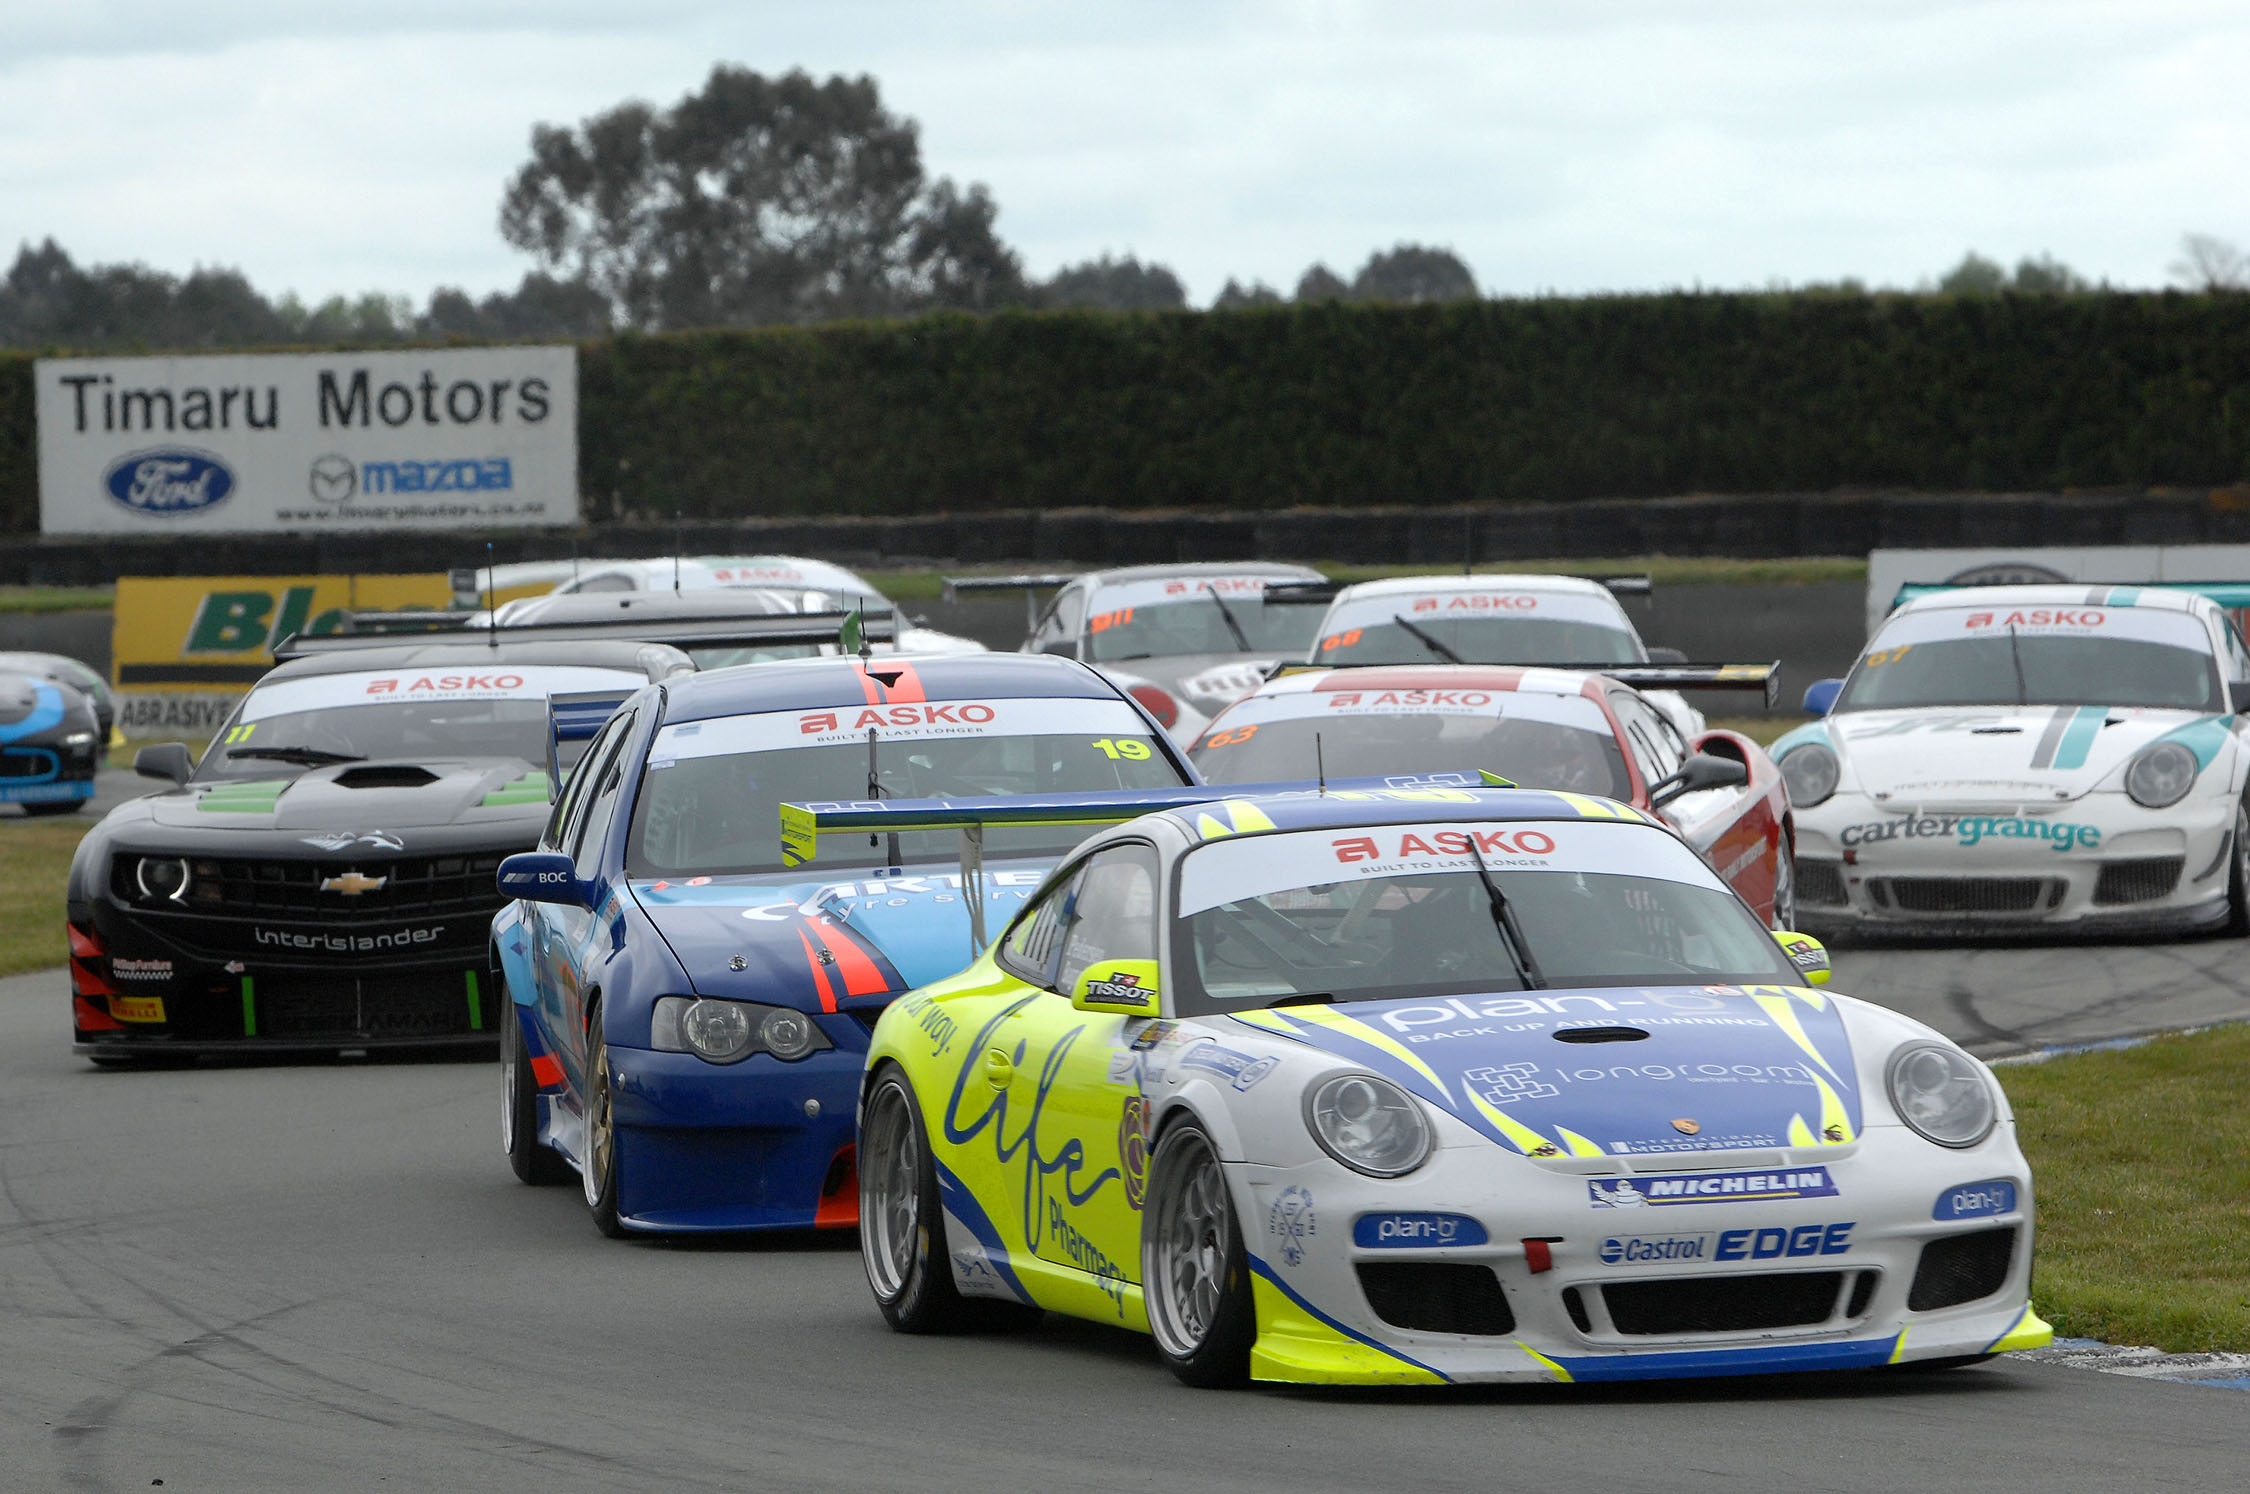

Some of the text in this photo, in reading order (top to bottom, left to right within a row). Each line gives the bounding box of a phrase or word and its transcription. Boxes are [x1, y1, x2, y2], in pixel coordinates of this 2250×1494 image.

[59, 368, 550, 433] Timaru Motors
[127, 459, 218, 506] Ford
[1448, 596, 1537, 610] ASKO
[1090, 608, 1133, 634] 911
[2004, 610, 2105, 626] ASKO
[408, 675, 524, 691] ASKO
[1373, 692, 1492, 707] ASKO
[855, 704, 996, 728] ASKO
[817, 733, 858, 743] BUILT
[886, 729, 919, 738] LAST
[926, 727, 984, 735] LONGER
[1208, 725, 1259, 748] 63
[1092, 738, 1152, 760] 19
[1400, 830, 1556, 857] ASKO
[1840, 813, 2102, 852] cartergrange
[539, 872, 567, 883] BOC
[1360, 858, 1550, 875] BUILT TO LAST LONGER
[255, 926, 445, 951] interislander
[1087, 981, 1156, 1000] TISSOT
[1381, 989, 1730, 1032] plan-b
[920, 1005, 958, 1058] way.
[1408, 1016, 1770, 1043] BACK UP AND RUNNING
[1556, 1063, 1811, 1084] longroom
[944, 993, 1121, 1254] life
[1630, 1139, 1777, 1153] MOTORSPORT
[1650, 1172, 1824, 1196] MICHELIN
[1378, 1216, 1457, 1241] plan-b
[1625, 1235, 1704, 1262] Castrol
[1713, 1222, 1857, 1262] EDGE
[1049, 1195, 1127, 1320] Pharmacy
